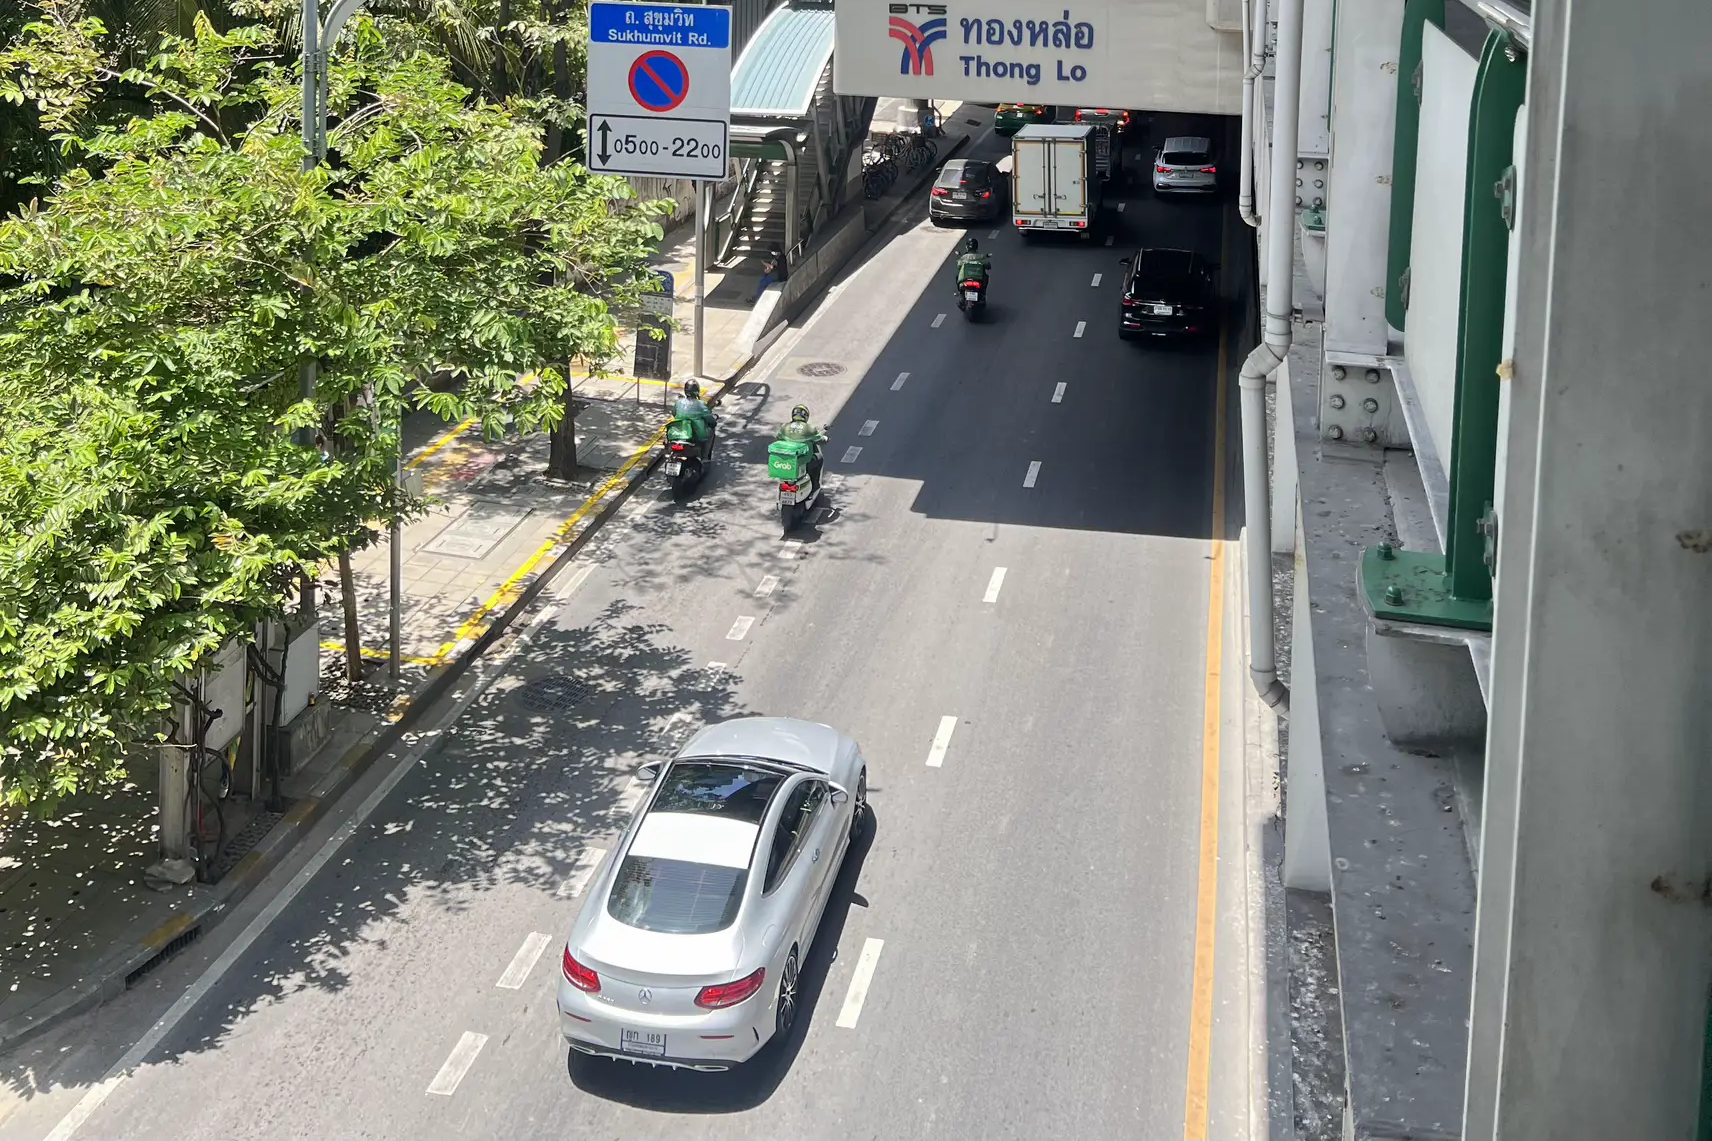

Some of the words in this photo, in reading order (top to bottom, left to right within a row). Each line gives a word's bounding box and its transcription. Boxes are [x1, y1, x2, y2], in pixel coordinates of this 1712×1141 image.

[888, 3, 948, 15] BTS
[625, 10, 639, 25] ถ.
[643, 8, 694, 31] สุขุมวิท
[608, 29, 682, 44] Sukhumvit
[688, 32, 711, 46] Rd.
[959, 10, 1095, 50] ทองหล่อ
[959, 55, 1041, 86] Thong
[1056, 60, 1088, 82] Lo
[773, 460, 792, 471] Grab
